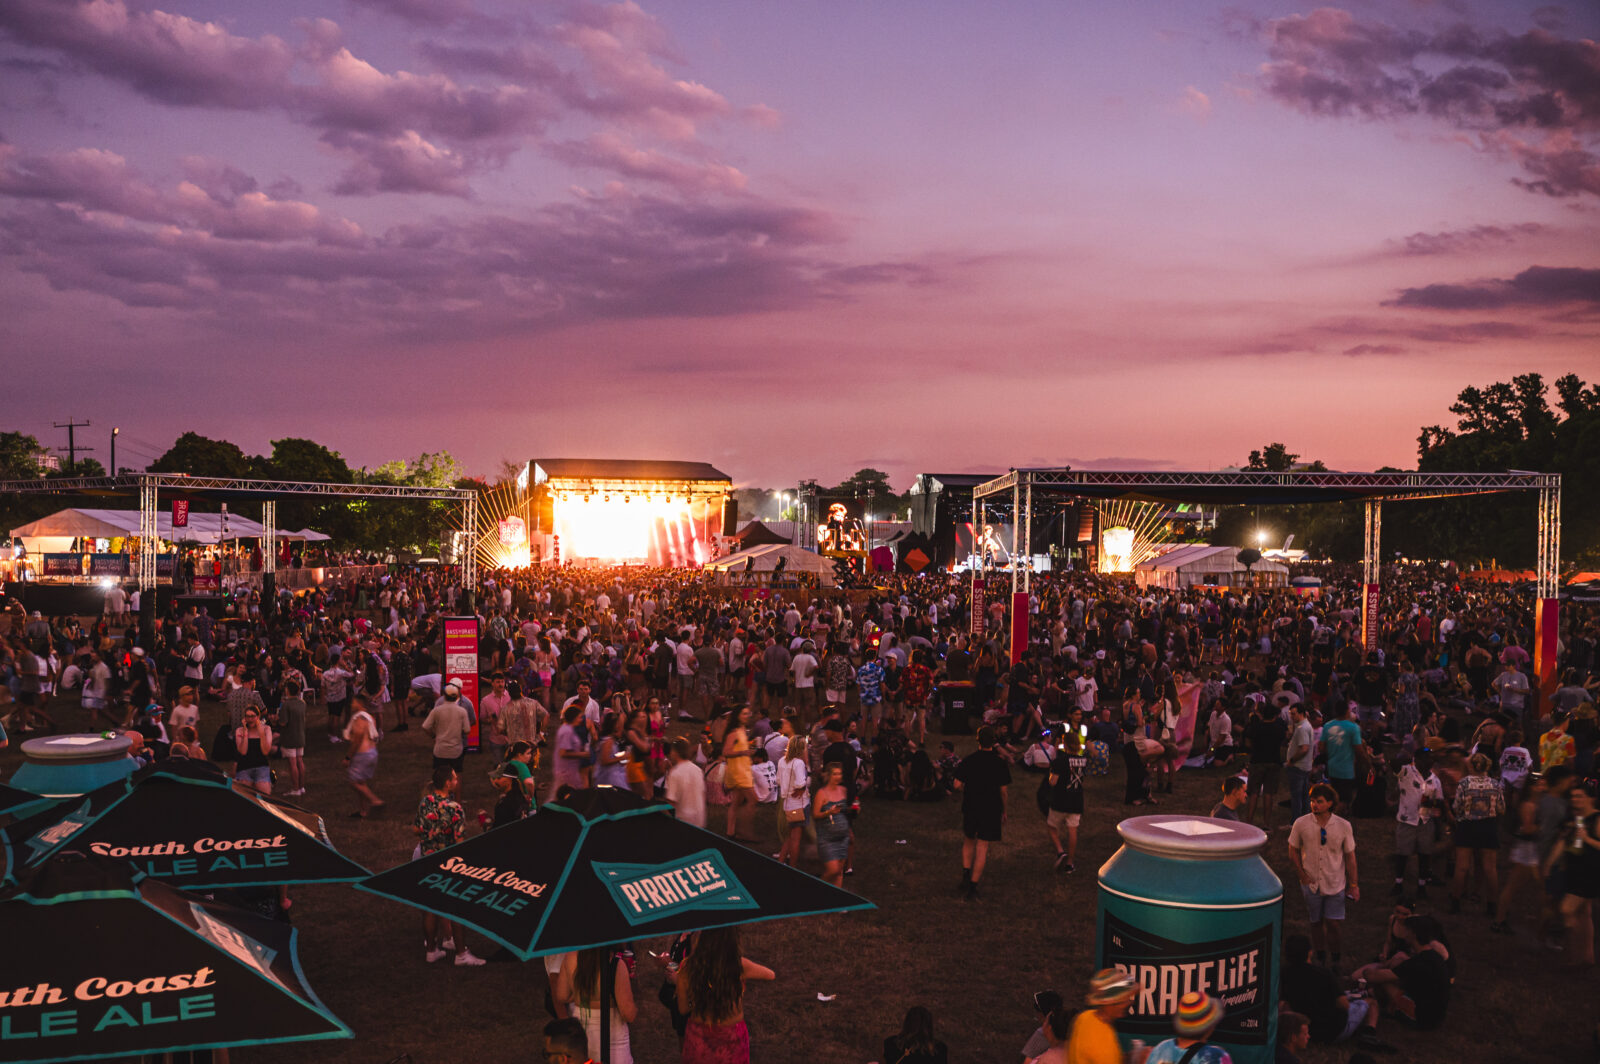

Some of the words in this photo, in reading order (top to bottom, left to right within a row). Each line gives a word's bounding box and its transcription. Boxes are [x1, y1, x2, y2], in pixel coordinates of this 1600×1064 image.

[90, 841, 189, 858] South
[194, 834, 288, 854] Coast
[209, 851, 289, 872] ALE
[418, 873, 485, 902] PALE
[475, 891, 529, 917] ALE
[439, 856, 498, 882] South
[493, 871, 547, 898] Coast
[74, 966, 217, 1001] Coast
[93, 993, 217, 1033] ALE
